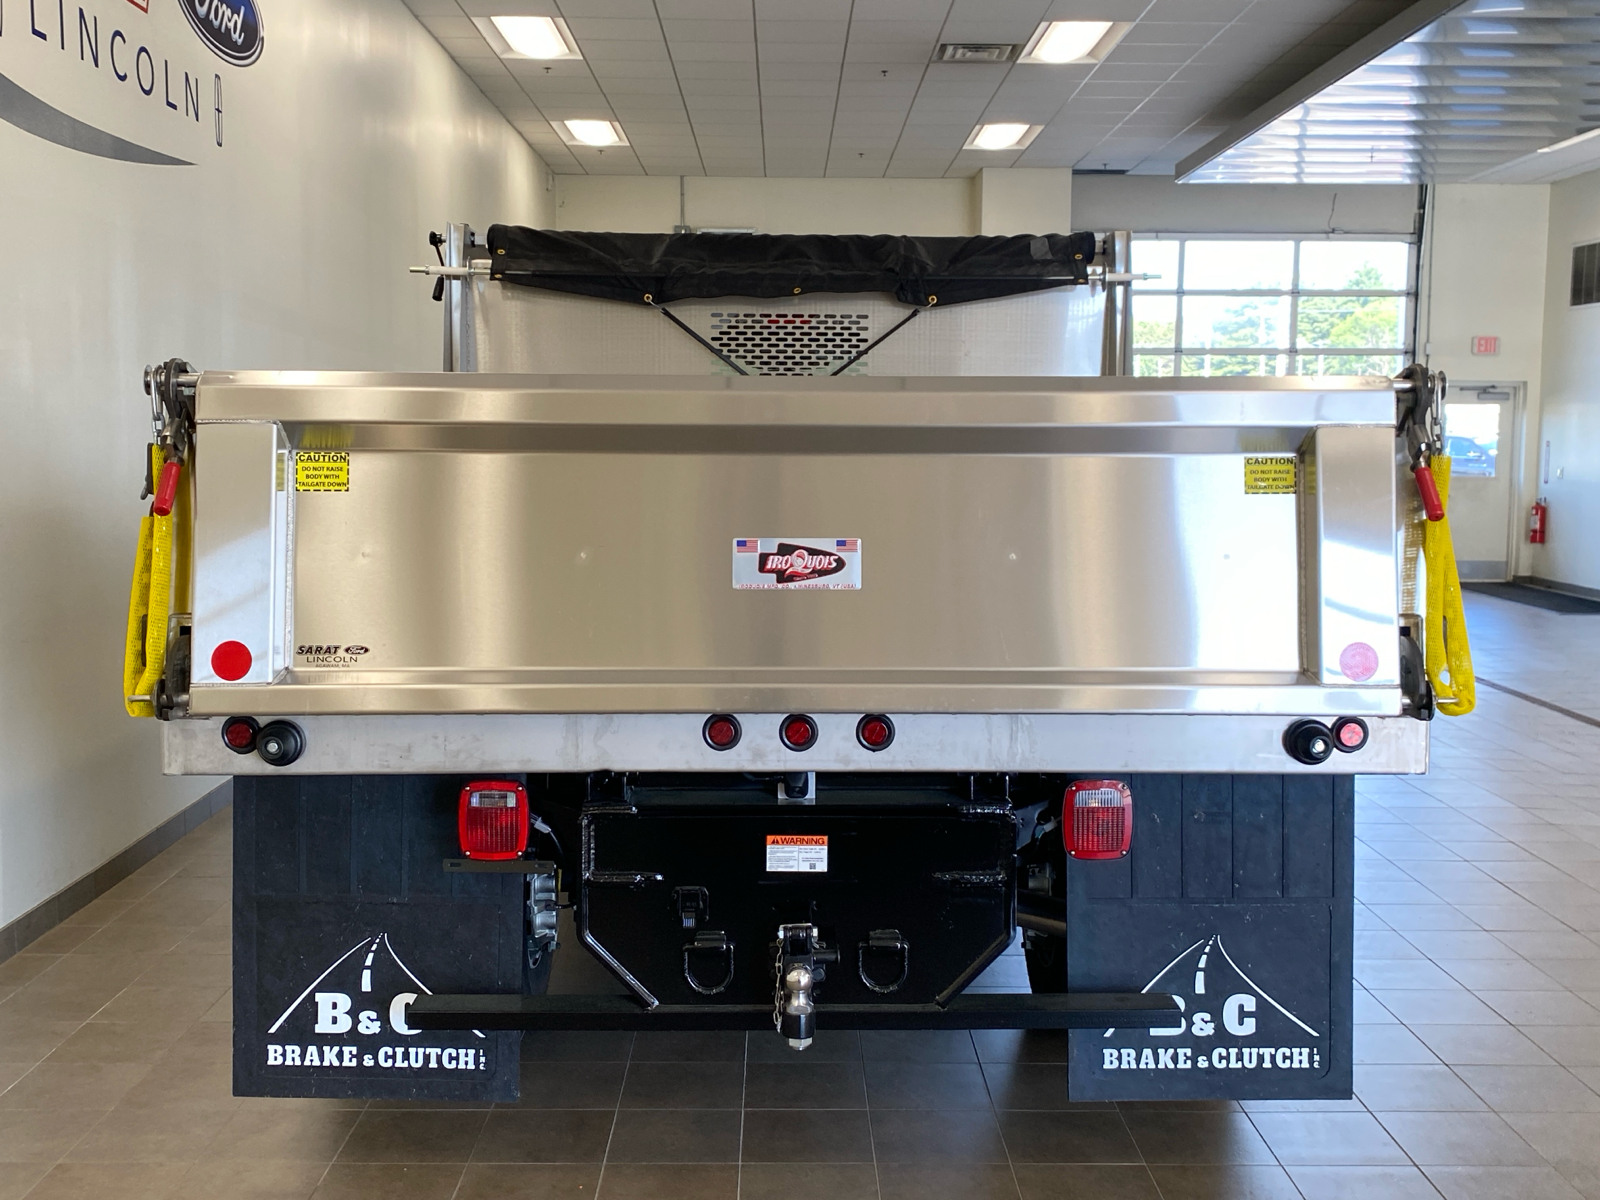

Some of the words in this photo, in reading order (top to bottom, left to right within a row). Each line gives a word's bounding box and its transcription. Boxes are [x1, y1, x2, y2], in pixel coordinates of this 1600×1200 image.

[30, 0, 200, 122] LINCOLN
[298, 454, 347, 462] CAUTION
[1246, 457, 1294, 465] CAUTION
[764, 549, 839, 574] IROQUOIS
[296, 645, 341, 655] SARAT
[780, 837, 825, 845] WARNING
[266, 1045, 357, 1067] BRAKE
[362, 1054, 375, 1067] &
[377, 1047, 476, 1070] CLUTCH
[1102, 1048, 1192, 1069] BRAKE
[1197, 1055, 1209, 1068] &
[1211, 1047, 1310, 1069] CLUTCH
